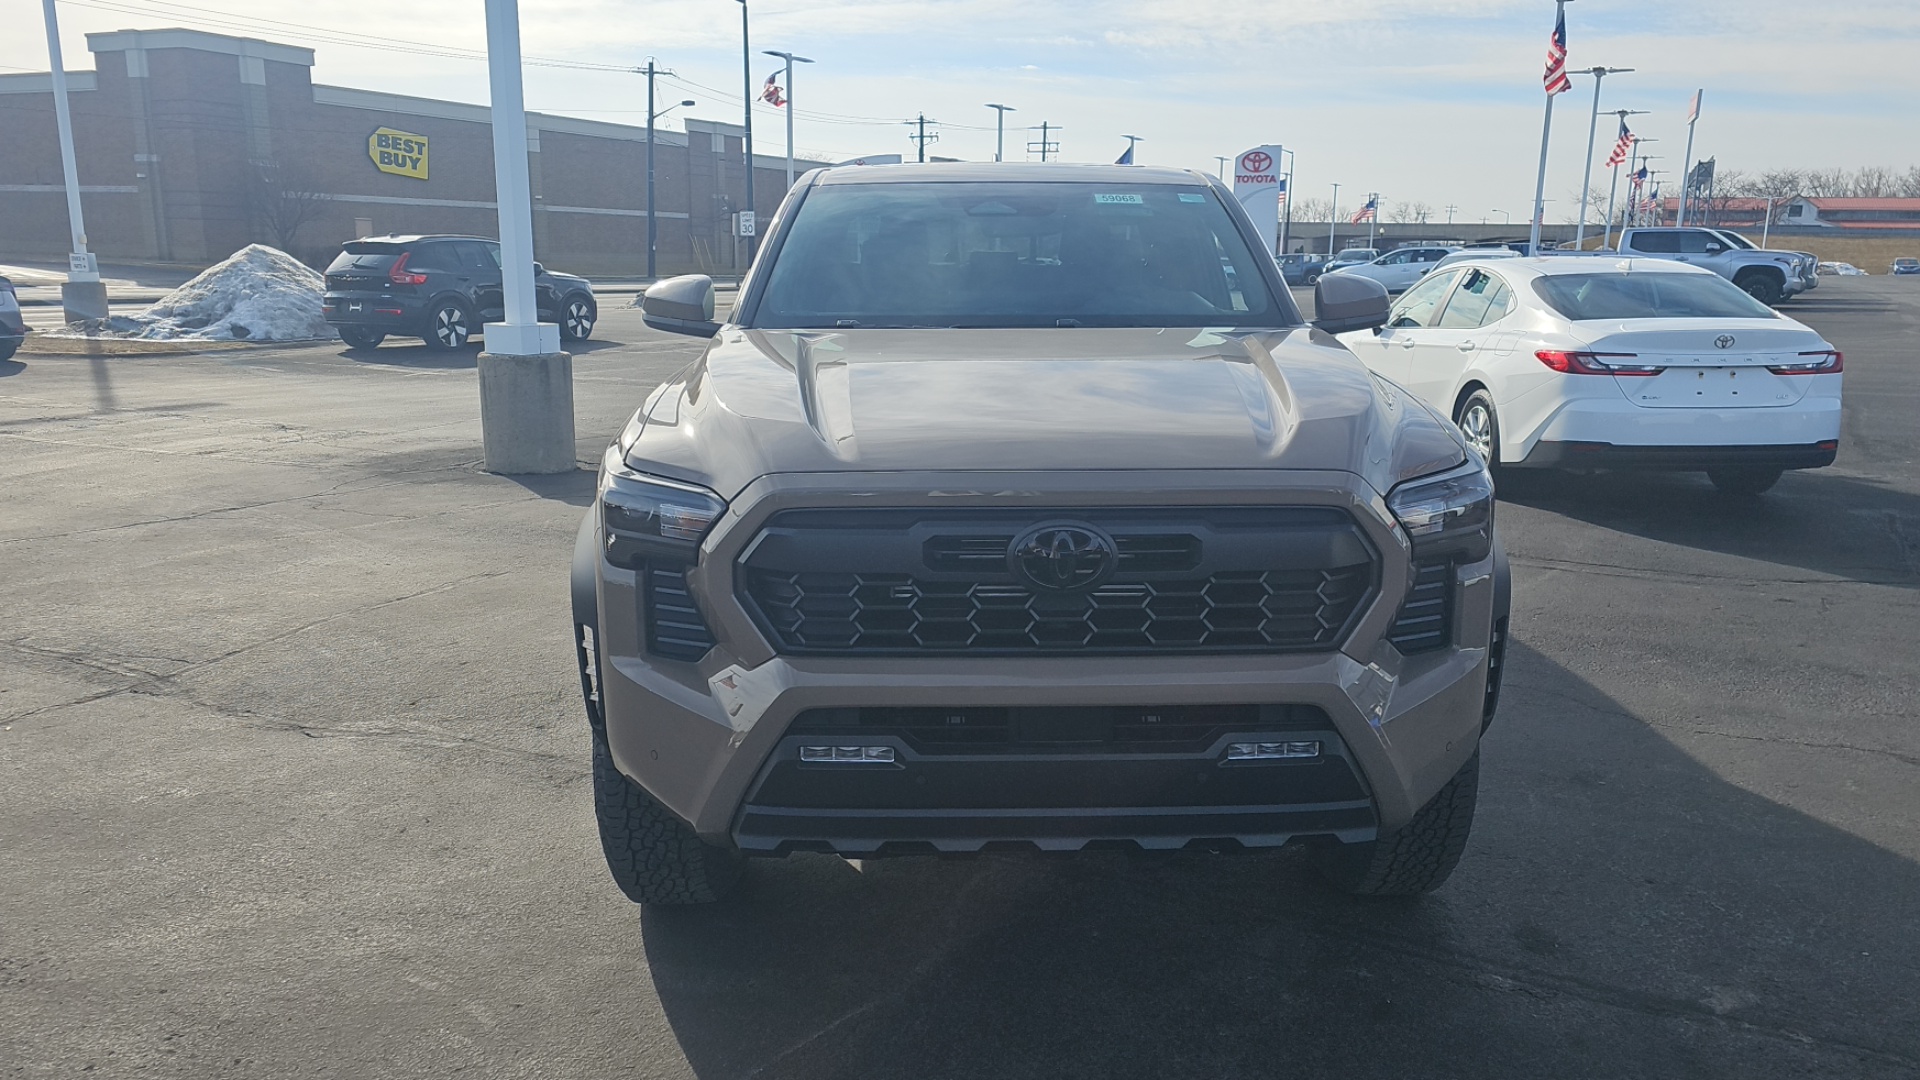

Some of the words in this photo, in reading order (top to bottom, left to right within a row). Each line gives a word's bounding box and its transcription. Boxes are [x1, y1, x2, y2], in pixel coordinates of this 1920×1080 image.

[376, 133, 426, 156] BEST
[379, 150, 421, 170] BUY
[1235, 174, 1277, 184] TOYOTA
[1101, 194, 1136, 203] 59068
[741, 223, 753, 234] 30
